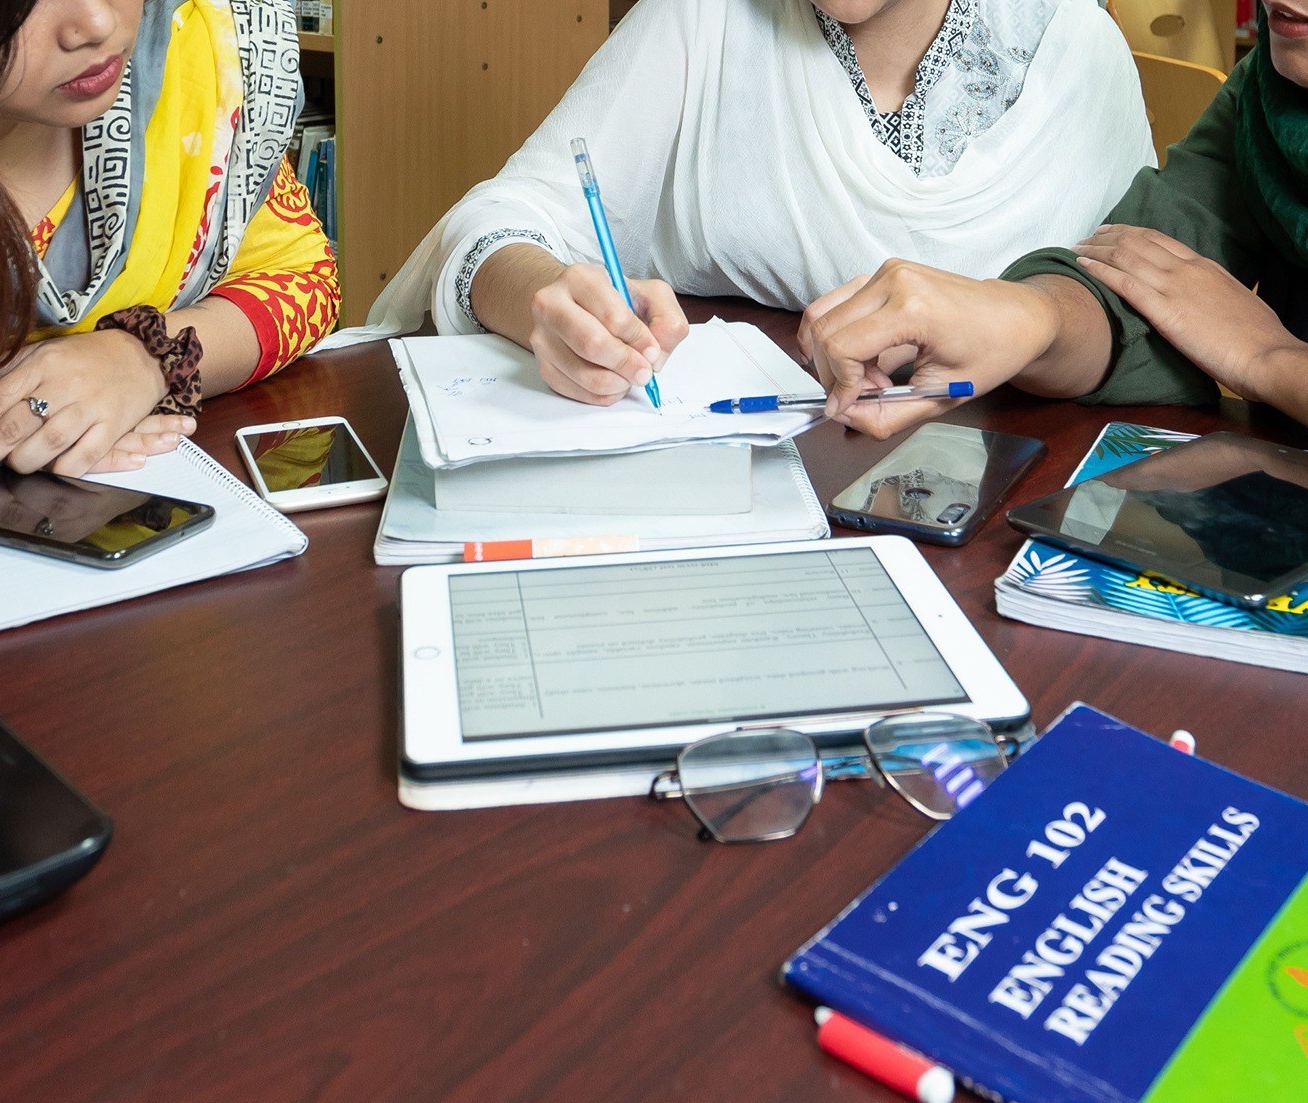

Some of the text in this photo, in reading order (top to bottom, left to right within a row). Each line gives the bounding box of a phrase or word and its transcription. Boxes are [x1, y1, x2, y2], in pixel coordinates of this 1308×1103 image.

[916, 800, 1108, 984] ENG 102
[988, 856, 1149, 1021] ENGLISH
[1044, 806, 1261, 1047] READING SKILLS
